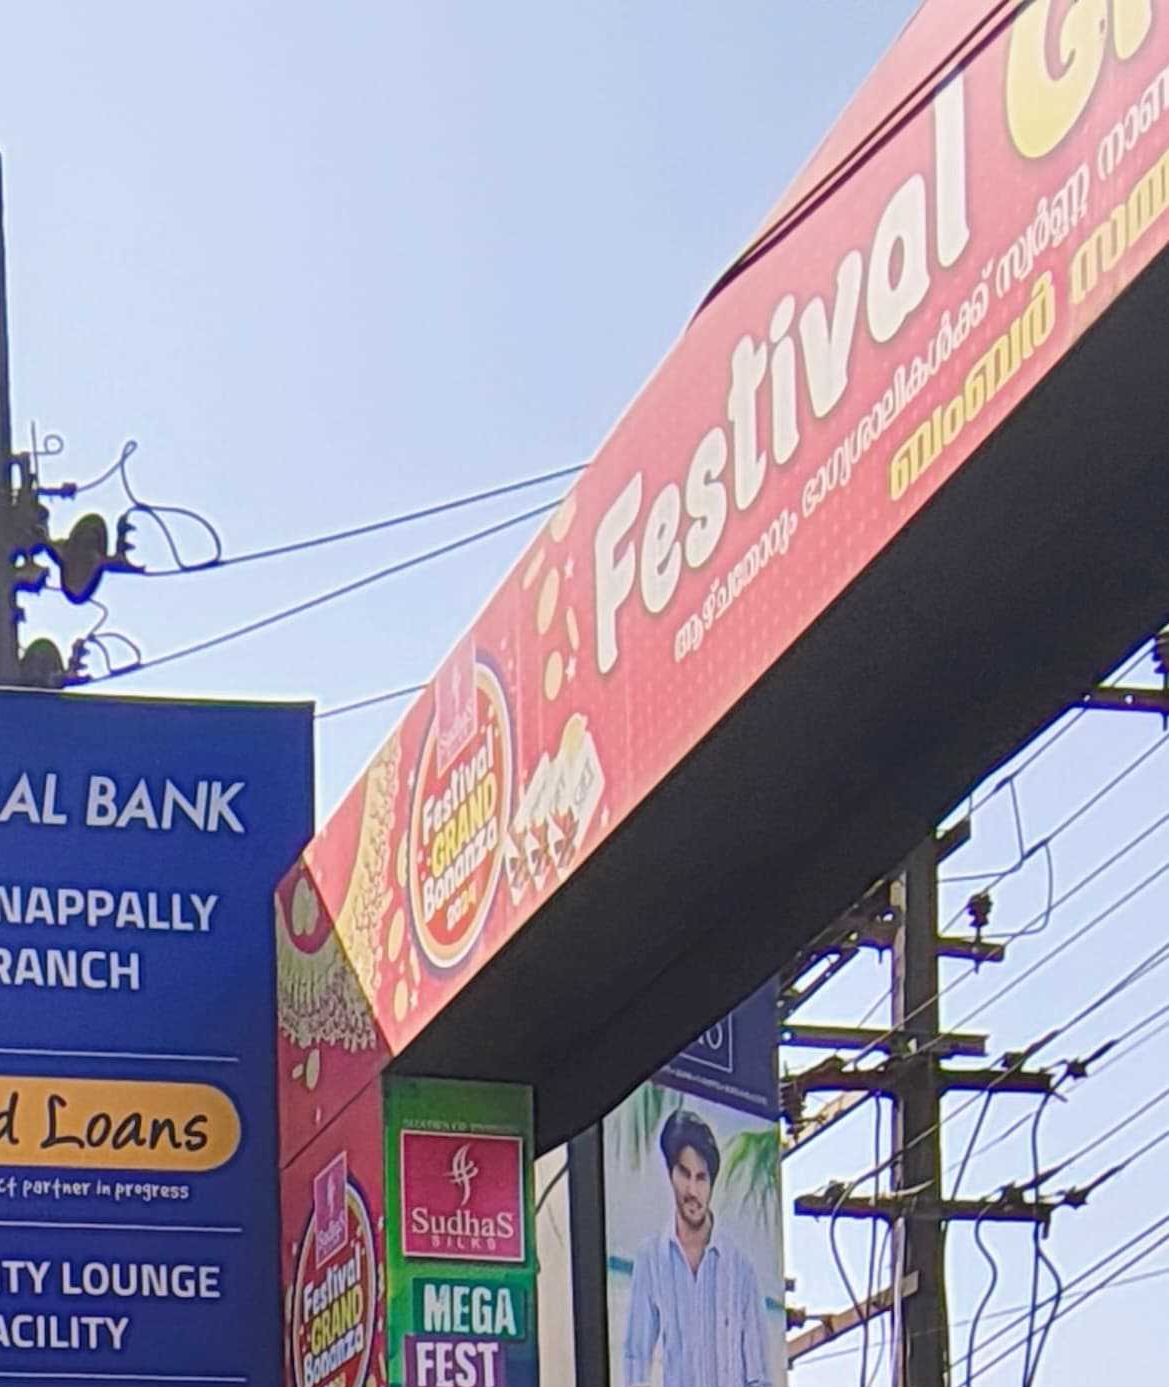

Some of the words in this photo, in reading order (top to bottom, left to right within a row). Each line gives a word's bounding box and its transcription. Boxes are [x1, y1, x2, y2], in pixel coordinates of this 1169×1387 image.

[594, 69, 970, 675] Festival
[85, 775, 246, 833] BANK
[431, 771, 497, 878] GRAND
[423, 815, 498, 922] Bonanza
[39, 1093, 210, 1153] Loans
[22, 1177, 92, 1200] partner
[96, 1180, 111, 1198] in
[114, 1180, 190, 1203] progress
[412, 1207, 514, 1238] SudhaS
[61, 1263, 222, 1300] LOUNGE
[303, 1243, 362, 1322] Festival
[423, 1284, 516, 1334] MEGA
[311, 1284, 363, 1356] GRAND
[416, 1342, 500, 1387] FEST
